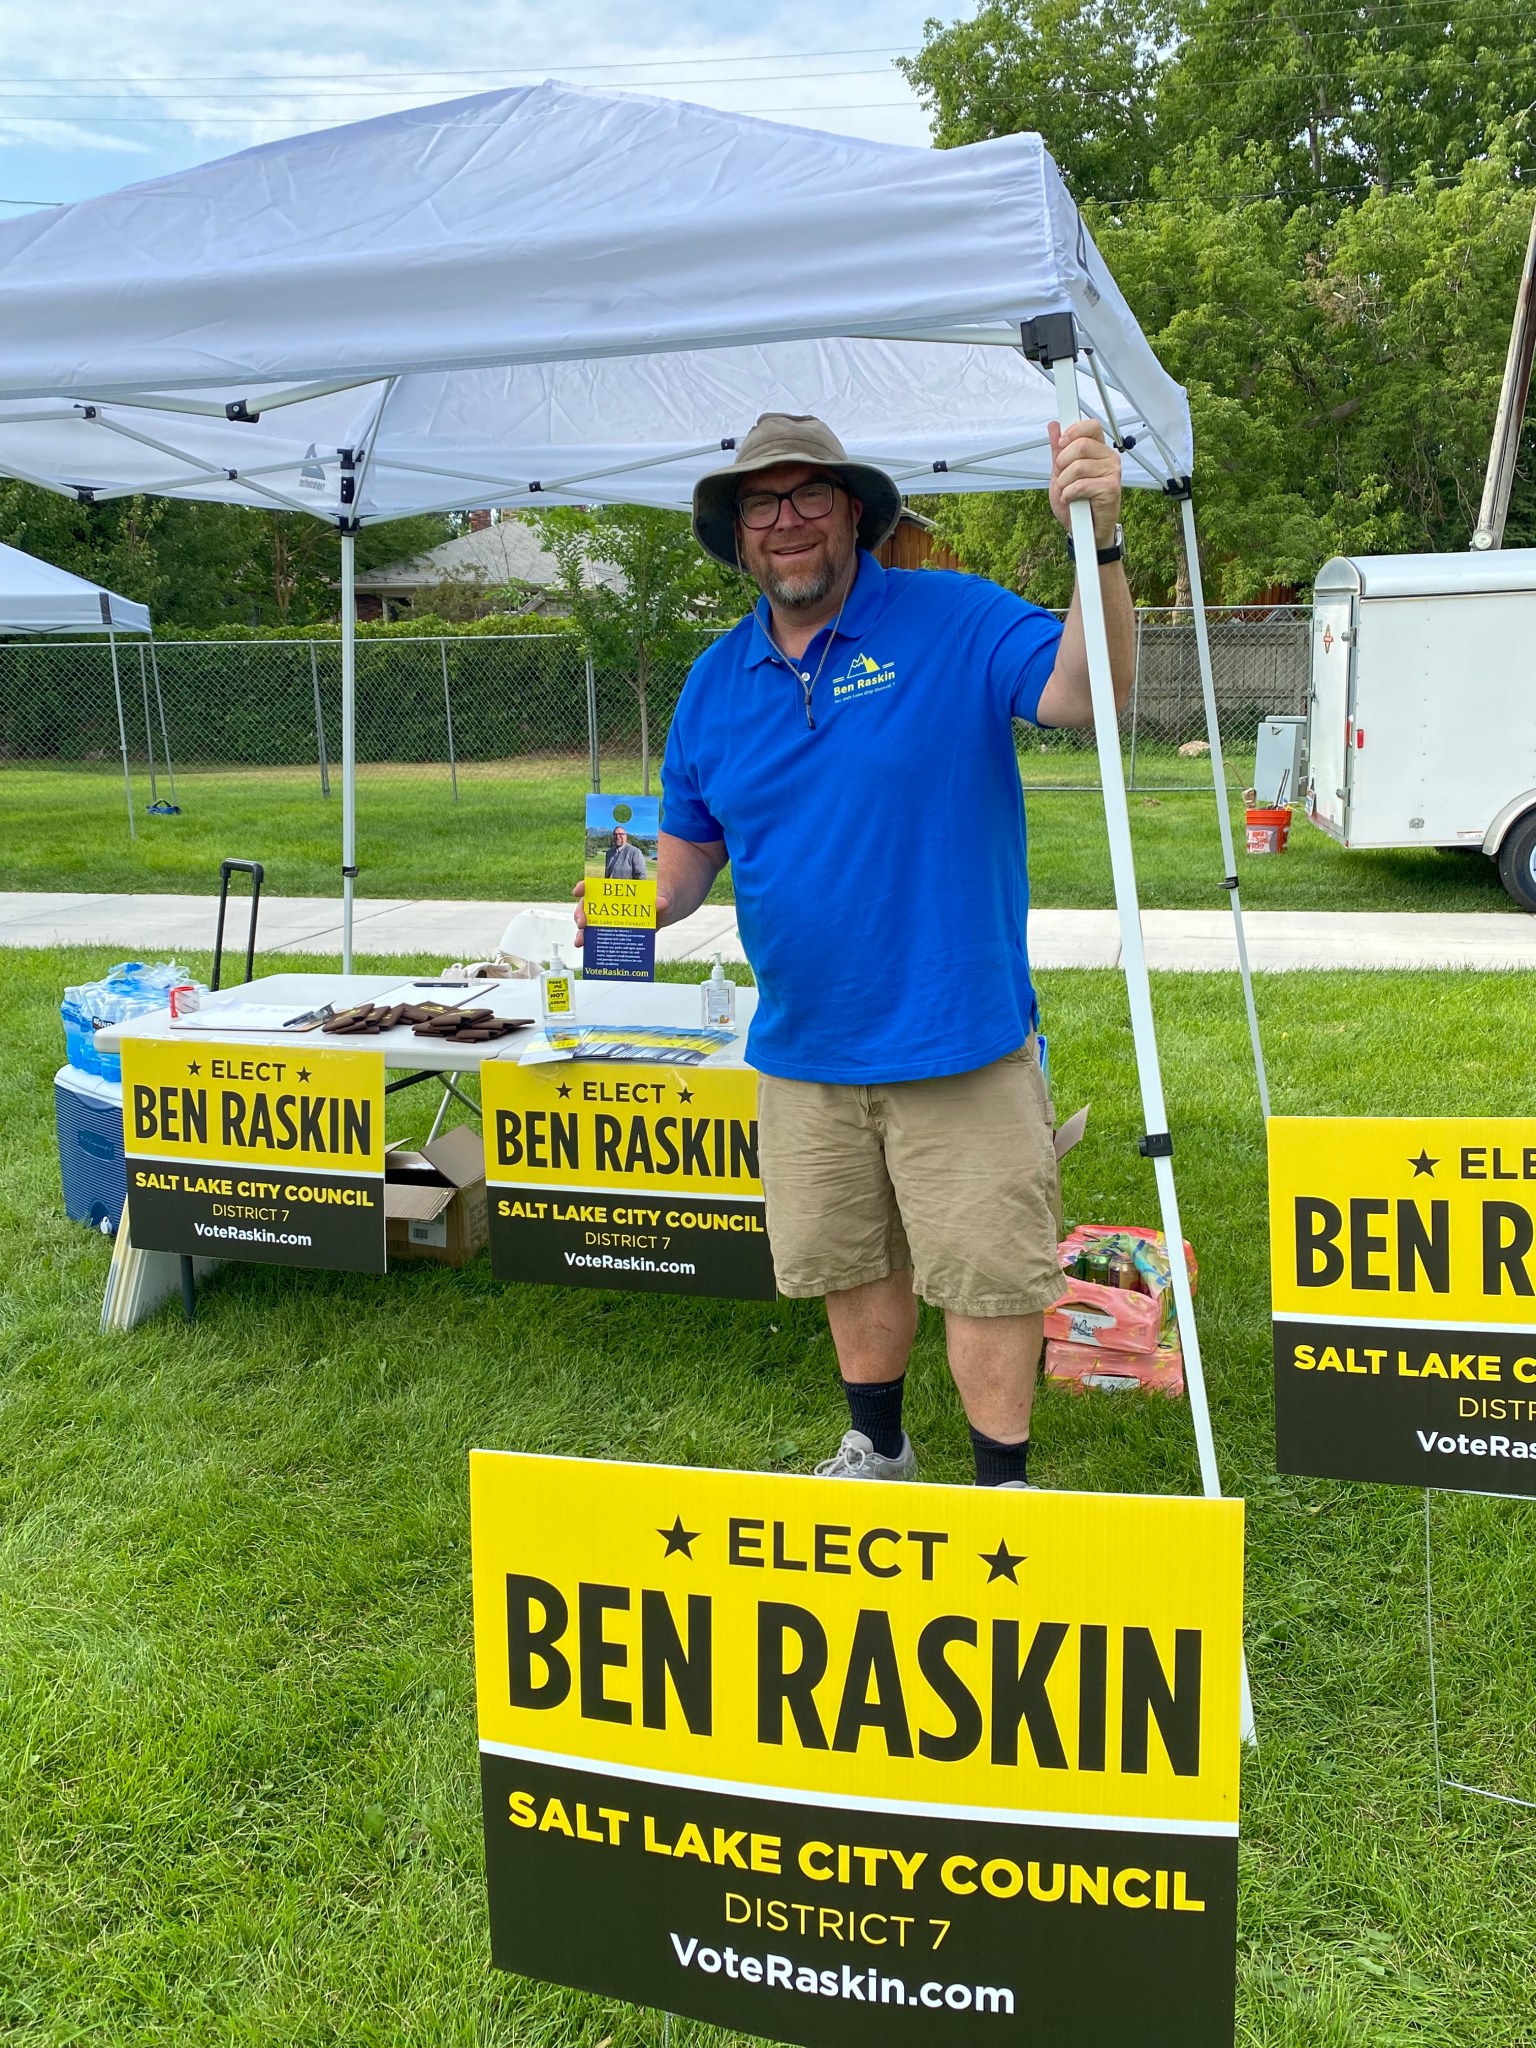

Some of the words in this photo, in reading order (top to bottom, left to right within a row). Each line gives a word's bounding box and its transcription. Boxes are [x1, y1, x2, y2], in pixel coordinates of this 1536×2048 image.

[834, 683, 854, 697] Ben
[857, 671, 895, 689] Raskin
[603, 883, 637, 898] BEN
[587, 902, 652, 918] RASKIN
[584, 967, 649, 977] VoteRaskin.com
[211, 1060, 287, 1082] ELECT
[583, 1082, 666, 1104] ELECT
[133, 1085, 208, 1144] BEN
[221, 1091, 371, 1156] RASKIN
[495, 1109, 580, 1170] BEN
[594, 1113, 760, 1179] RASKIN
[135, 1172, 180, 1191] SALT
[183, 1177, 233, 1196] LAKE
[236, 1181, 282, 1200] CITY
[284, 1185, 375, 1207] COUNCIL
[212, 1203, 278, 1221] DISTRICT
[281, 1209, 290, 1222] 7
[497, 1200, 548, 1219] SALT
[552, 1204, 608, 1223] LAKE
[612, 1207, 662, 1227] CITY
[665, 1211, 765, 1233] COUNCIL
[194, 1222, 312, 1247] VoteRaskin.com
[585, 1231, 658, 1249] DISTRICT
[661, 1236, 671, 1250] 7
[1294, 1196, 1450, 1294] BEN
[563, 1251, 696, 1275] VoteRaskin.com
[1293, 1344, 1388, 1375] SALT
[1398, 1350, 1502, 1382] LAKE
[728, 1517, 949, 1581] ELECT
[505, 1573, 713, 1737] BEN
[757, 1600, 1202, 1777] RASKIN
[508, 1790, 630, 1846] SALT
[643, 1815, 782, 1875] LAKE
[797, 1840, 929, 1891] CITY
[940, 1854, 1206, 1912] COUNCIL
[725, 1893, 915, 1946] DISTRICT
[928, 1918, 951, 1950] 7
[669, 1932, 1015, 2015] VoteRaskin.com
